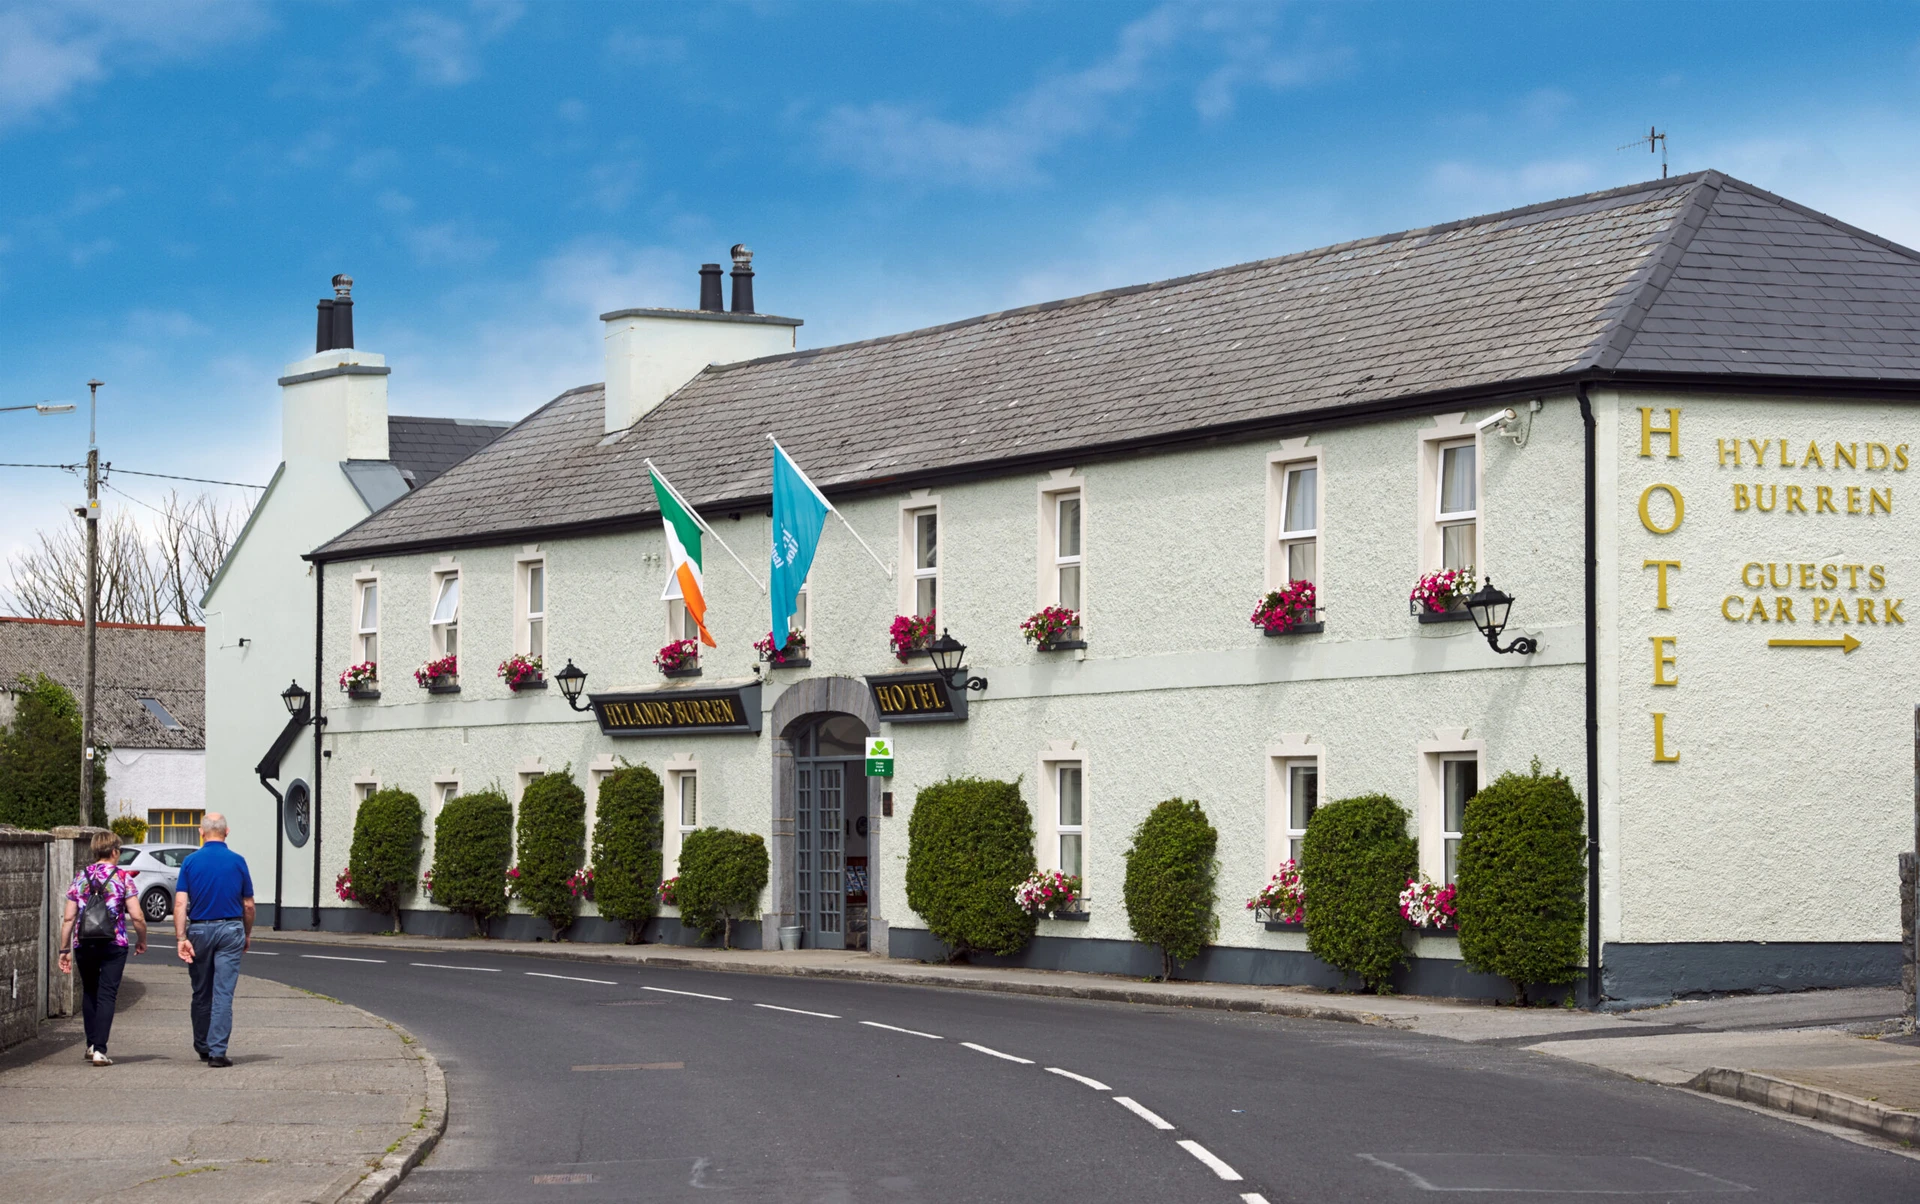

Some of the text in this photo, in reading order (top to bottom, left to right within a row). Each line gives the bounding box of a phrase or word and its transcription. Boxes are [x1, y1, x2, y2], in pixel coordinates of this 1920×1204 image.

[1718, 438, 1909, 471] HYLANDS
[1733, 483, 1893, 514] BURREN
[1637, 406, 1685, 763] HOTEL
[1741, 562, 1886, 590] GUESTS
[1721, 595, 1906, 624] CAR PARK
[875, 682, 946, 712] HOTEL
[603, 699, 735, 726] HYLANDS BURREN
